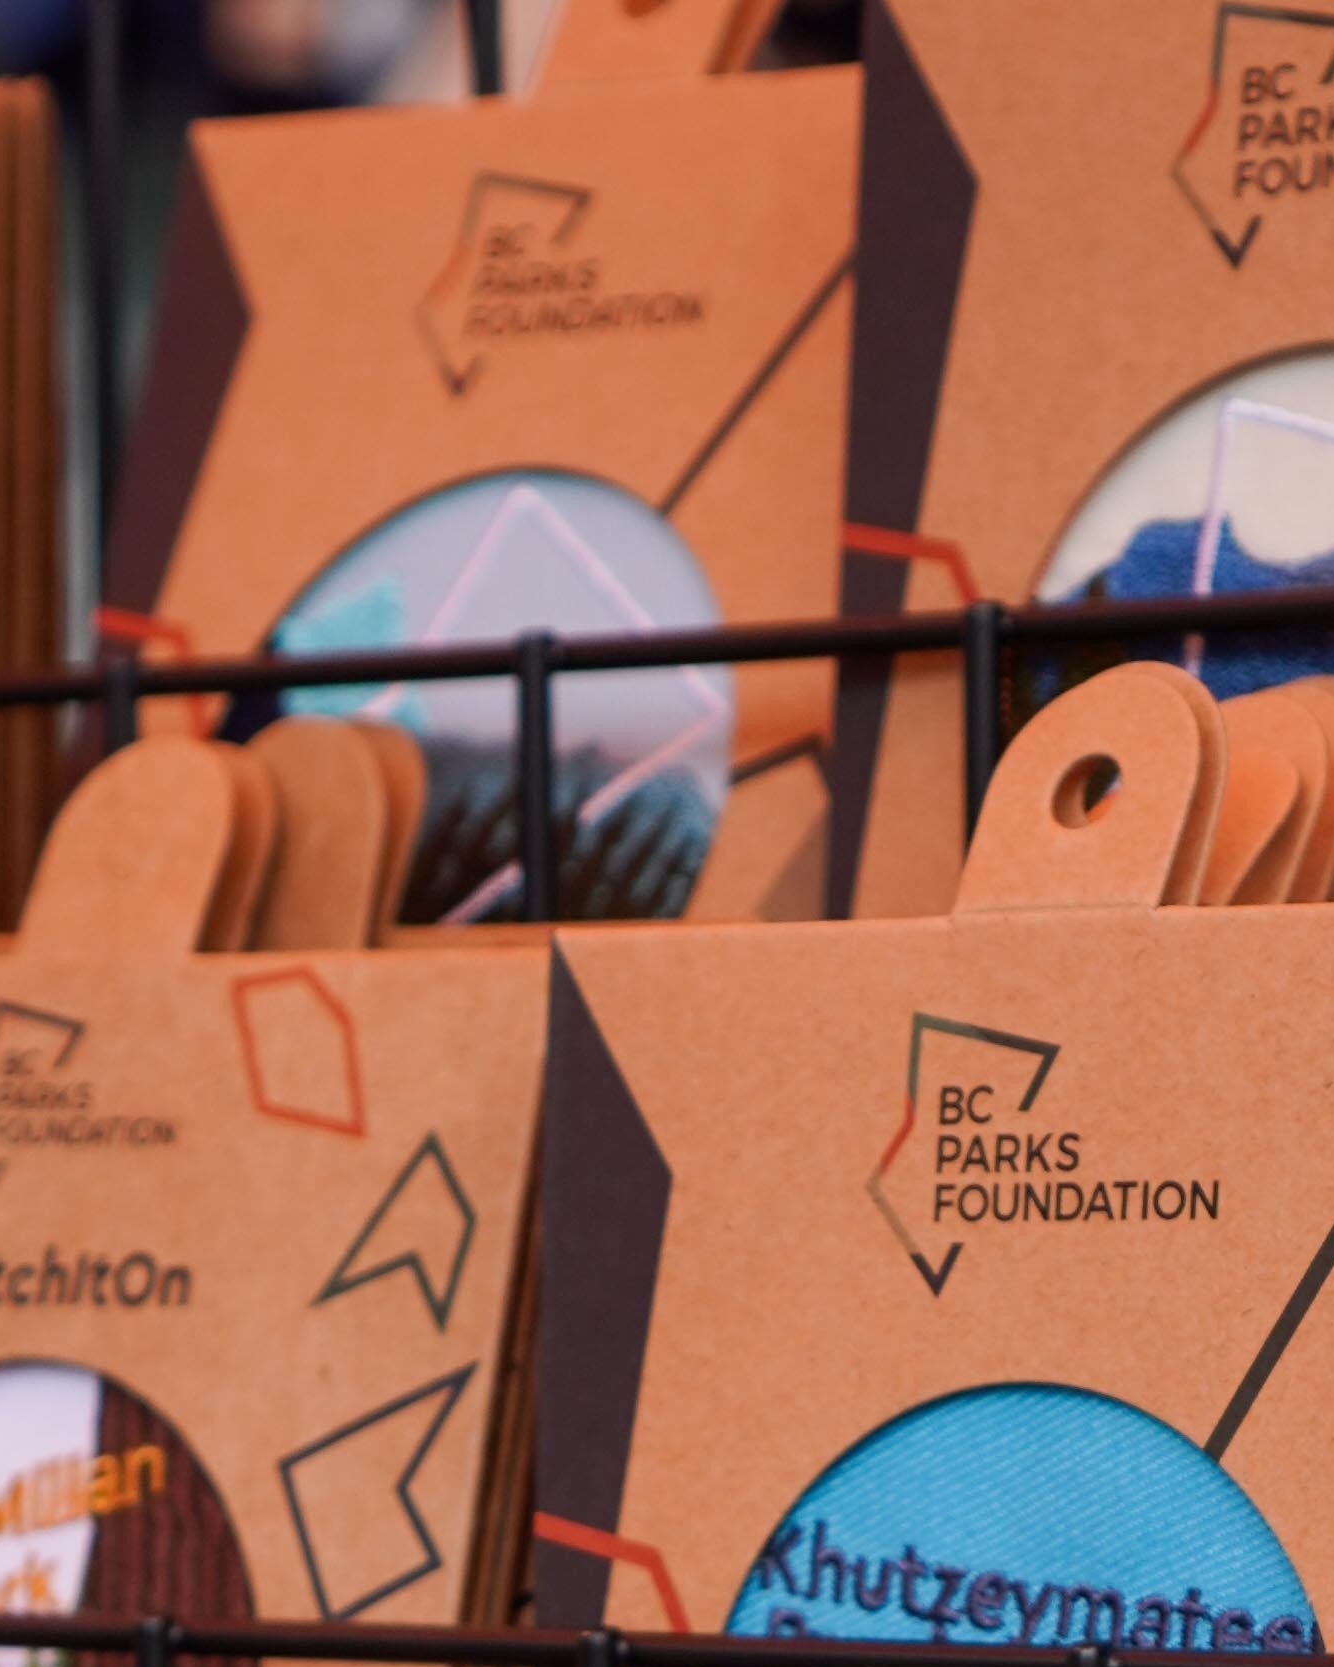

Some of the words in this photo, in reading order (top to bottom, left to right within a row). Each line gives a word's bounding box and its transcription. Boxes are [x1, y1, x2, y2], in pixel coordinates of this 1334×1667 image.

[1242, 63, 1298, 105] BC
[939, 1085, 994, 1125] BC
[936, 1133, 1081, 1174] PARKS
[934, 1180, 1220, 1222] FOUNDATION
[759, 1518, 1326, 1654] Khutzeymatee
